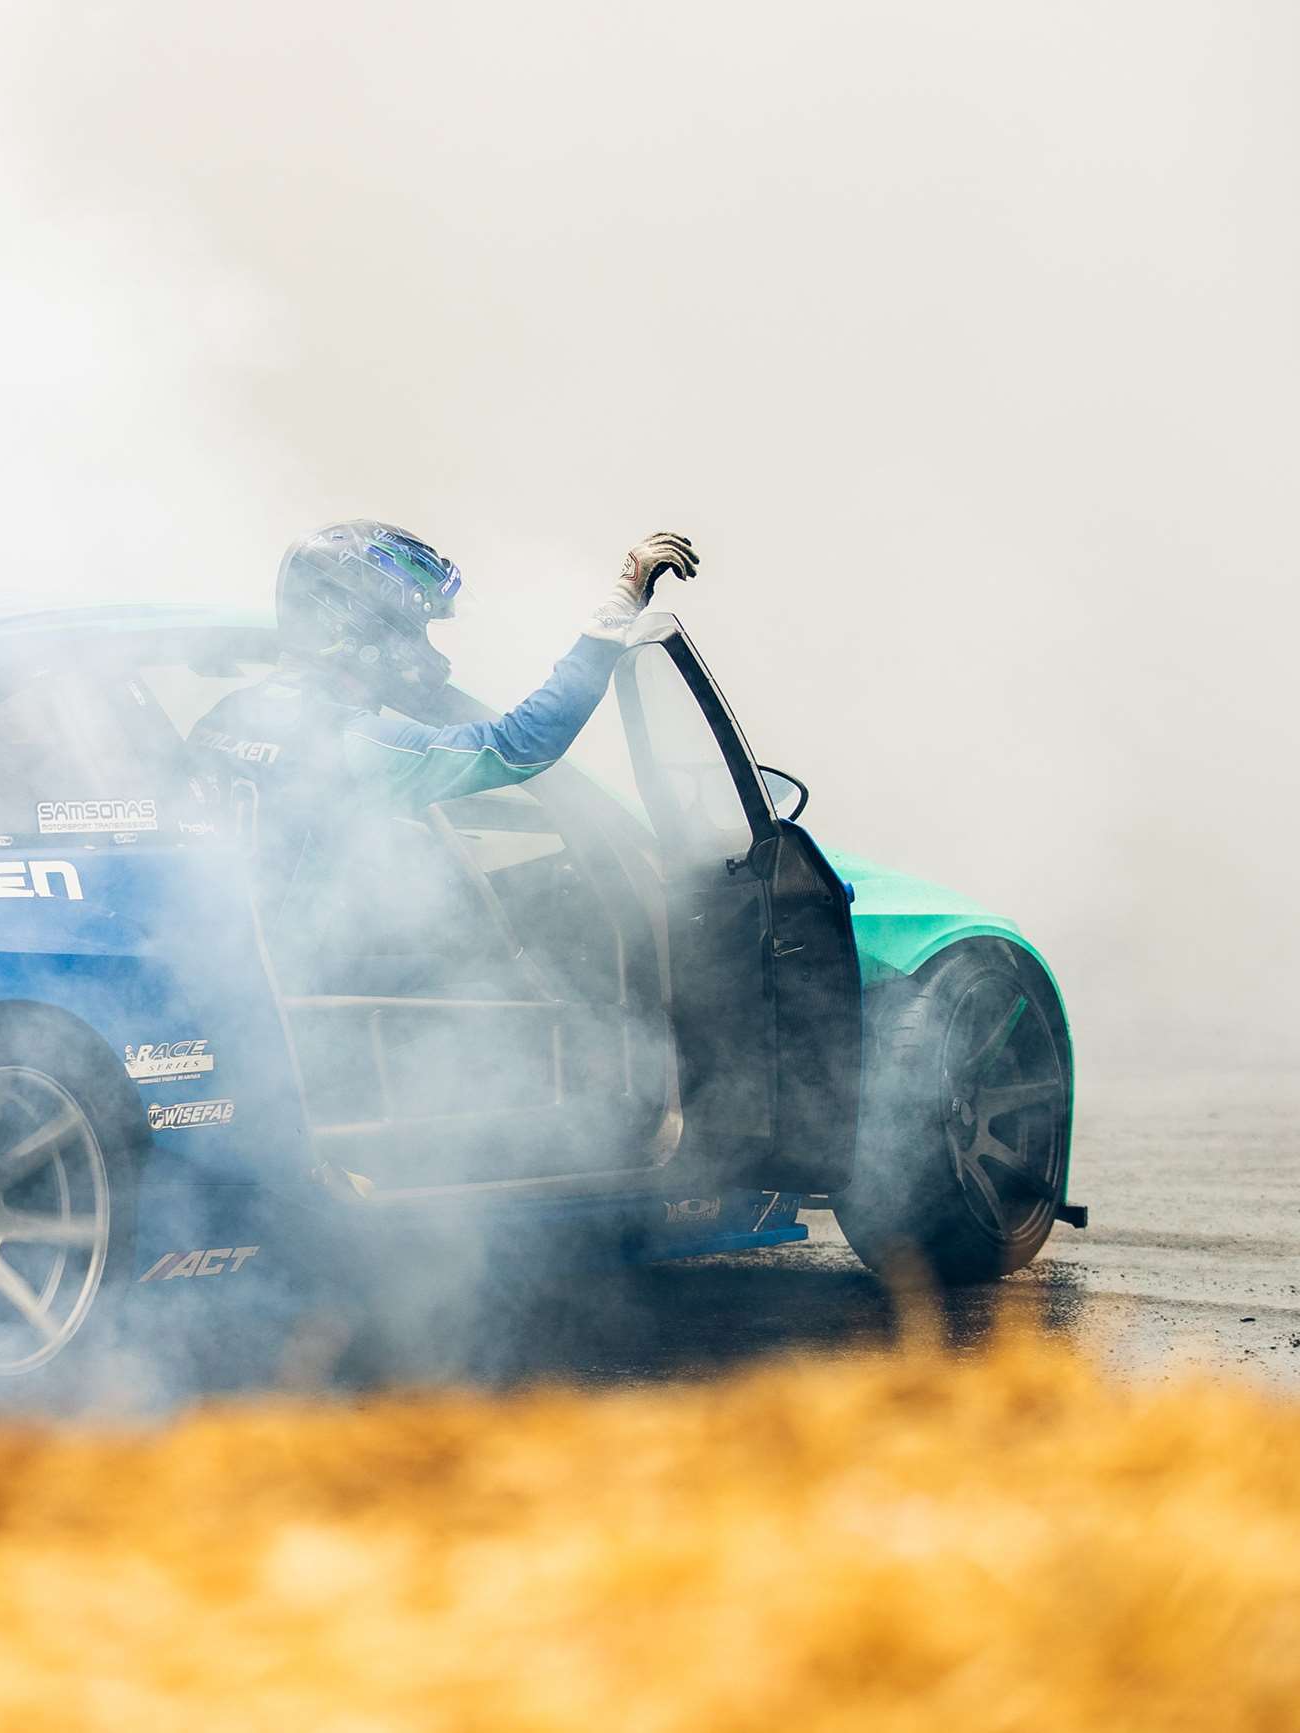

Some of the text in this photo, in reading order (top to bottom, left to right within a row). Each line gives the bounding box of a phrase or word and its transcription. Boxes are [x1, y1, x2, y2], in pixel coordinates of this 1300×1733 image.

[39, 802, 155, 821] SAMSONAS
[137, 1039, 209, 1062] RACE
[148, 1060, 200, 1073] SERIES
[164, 1103, 235, 1126] WISEFAB
